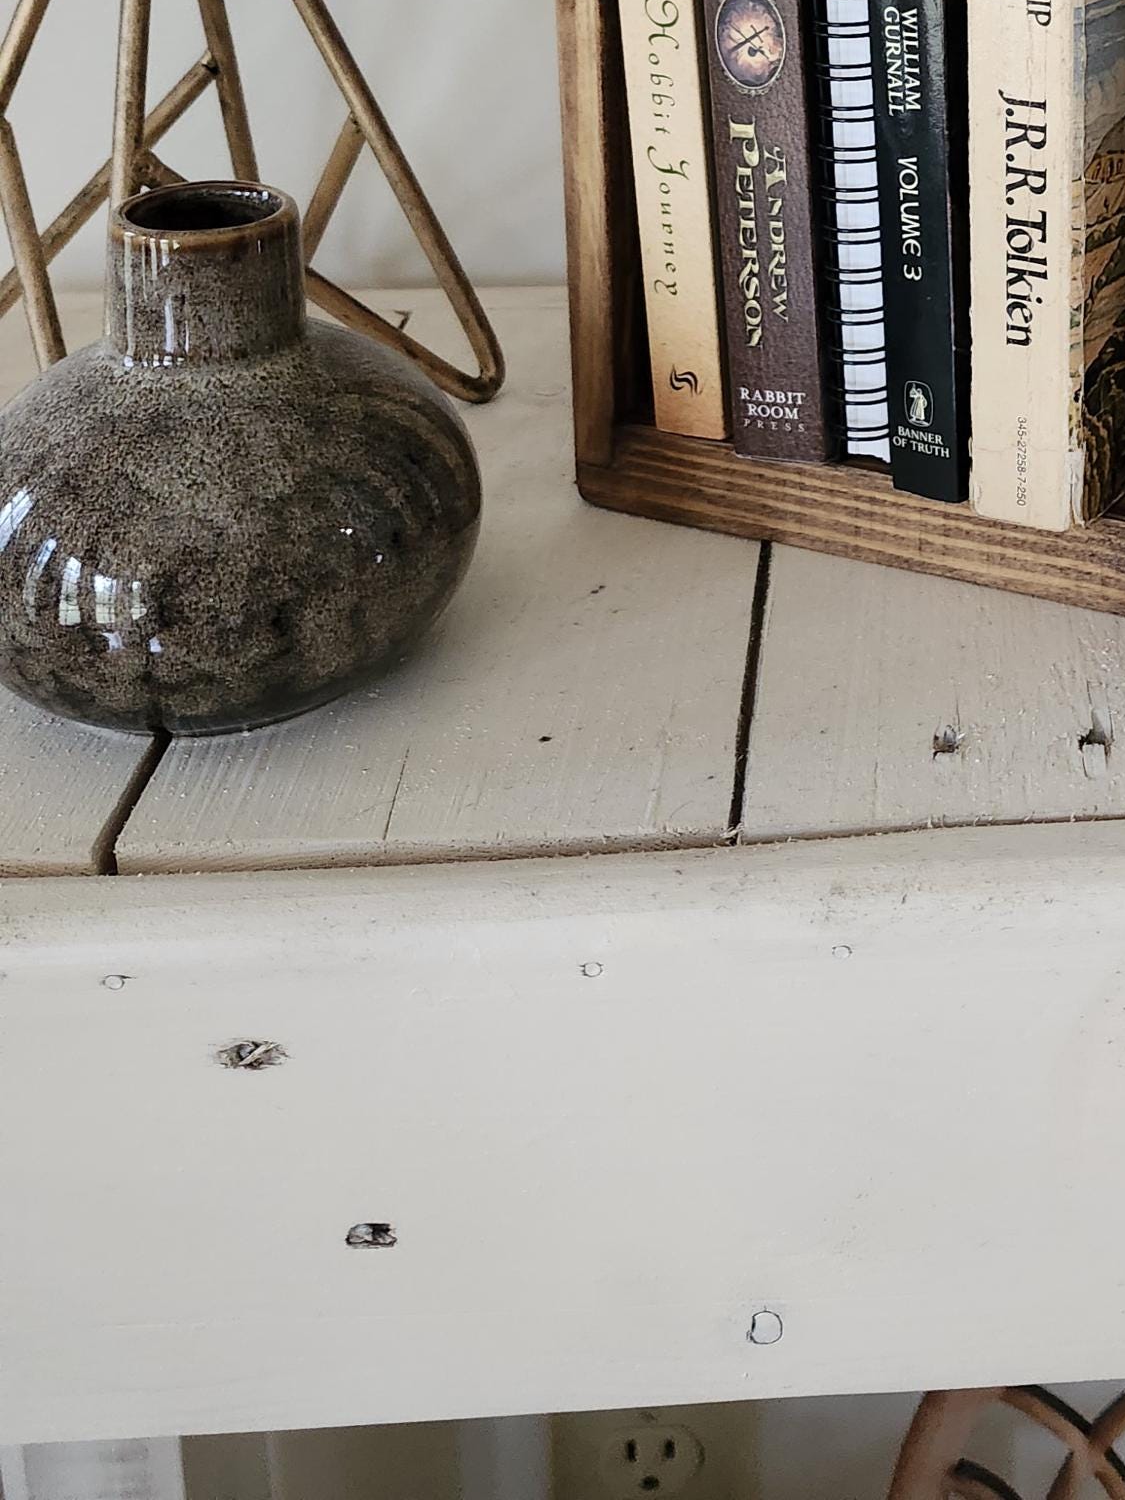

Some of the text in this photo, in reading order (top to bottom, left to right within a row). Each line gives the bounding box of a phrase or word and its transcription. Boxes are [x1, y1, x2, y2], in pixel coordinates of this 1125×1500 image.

[883, 6, 905, 117] GURNALL
[901, 8, 922, 110] WILLIAM
[646, 144, 691, 298] Journey
[728, 113, 764, 349] PETERSON
[763, 145, 789, 323] ANDREW
[897, 156, 923, 282] VOLUME 3
[998, 88, 1049, 347] J.R.R. Tolkien
[739, 386, 806, 405] RABBIT
[742, 418, 806, 433] PRESS
[748, 402, 799, 420] ROOM
[897, 426, 944, 446] BANNER
[892, 435, 951, 459] OF TRUTH
[1015, 416, 1028, 507] 345-27258-7-250
